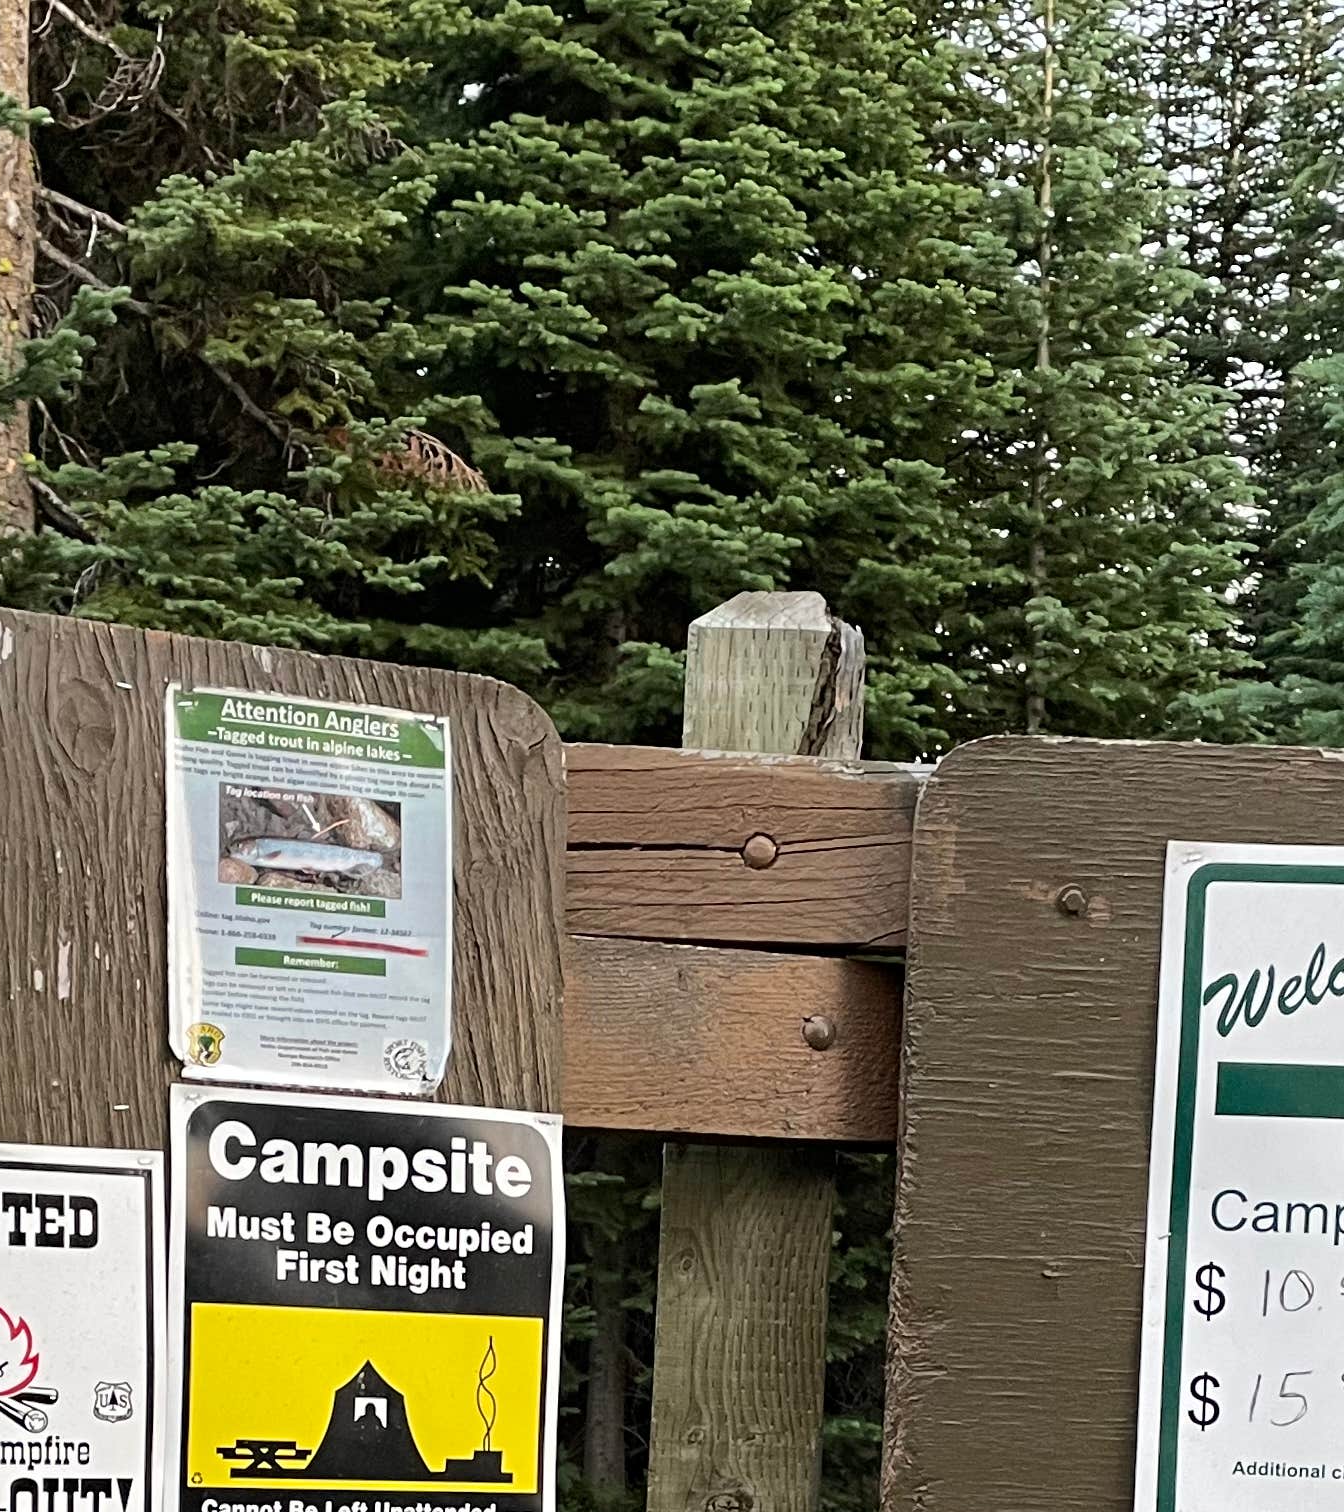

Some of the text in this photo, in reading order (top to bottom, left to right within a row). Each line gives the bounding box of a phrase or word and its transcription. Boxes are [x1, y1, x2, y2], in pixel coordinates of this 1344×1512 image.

[221, 698, 400, 738] Attention Anglers
[268, 733, 303, 748] trout
[307, 737, 320, 750] in
[323, 739, 363, 758] alpine
[367, 743, 400, 760] lakes
[209, 1120, 531, 1201] Campsite
[207, 1206, 533, 1257] Must Be Occupied
[277, 1250, 465, 1294] First Night
